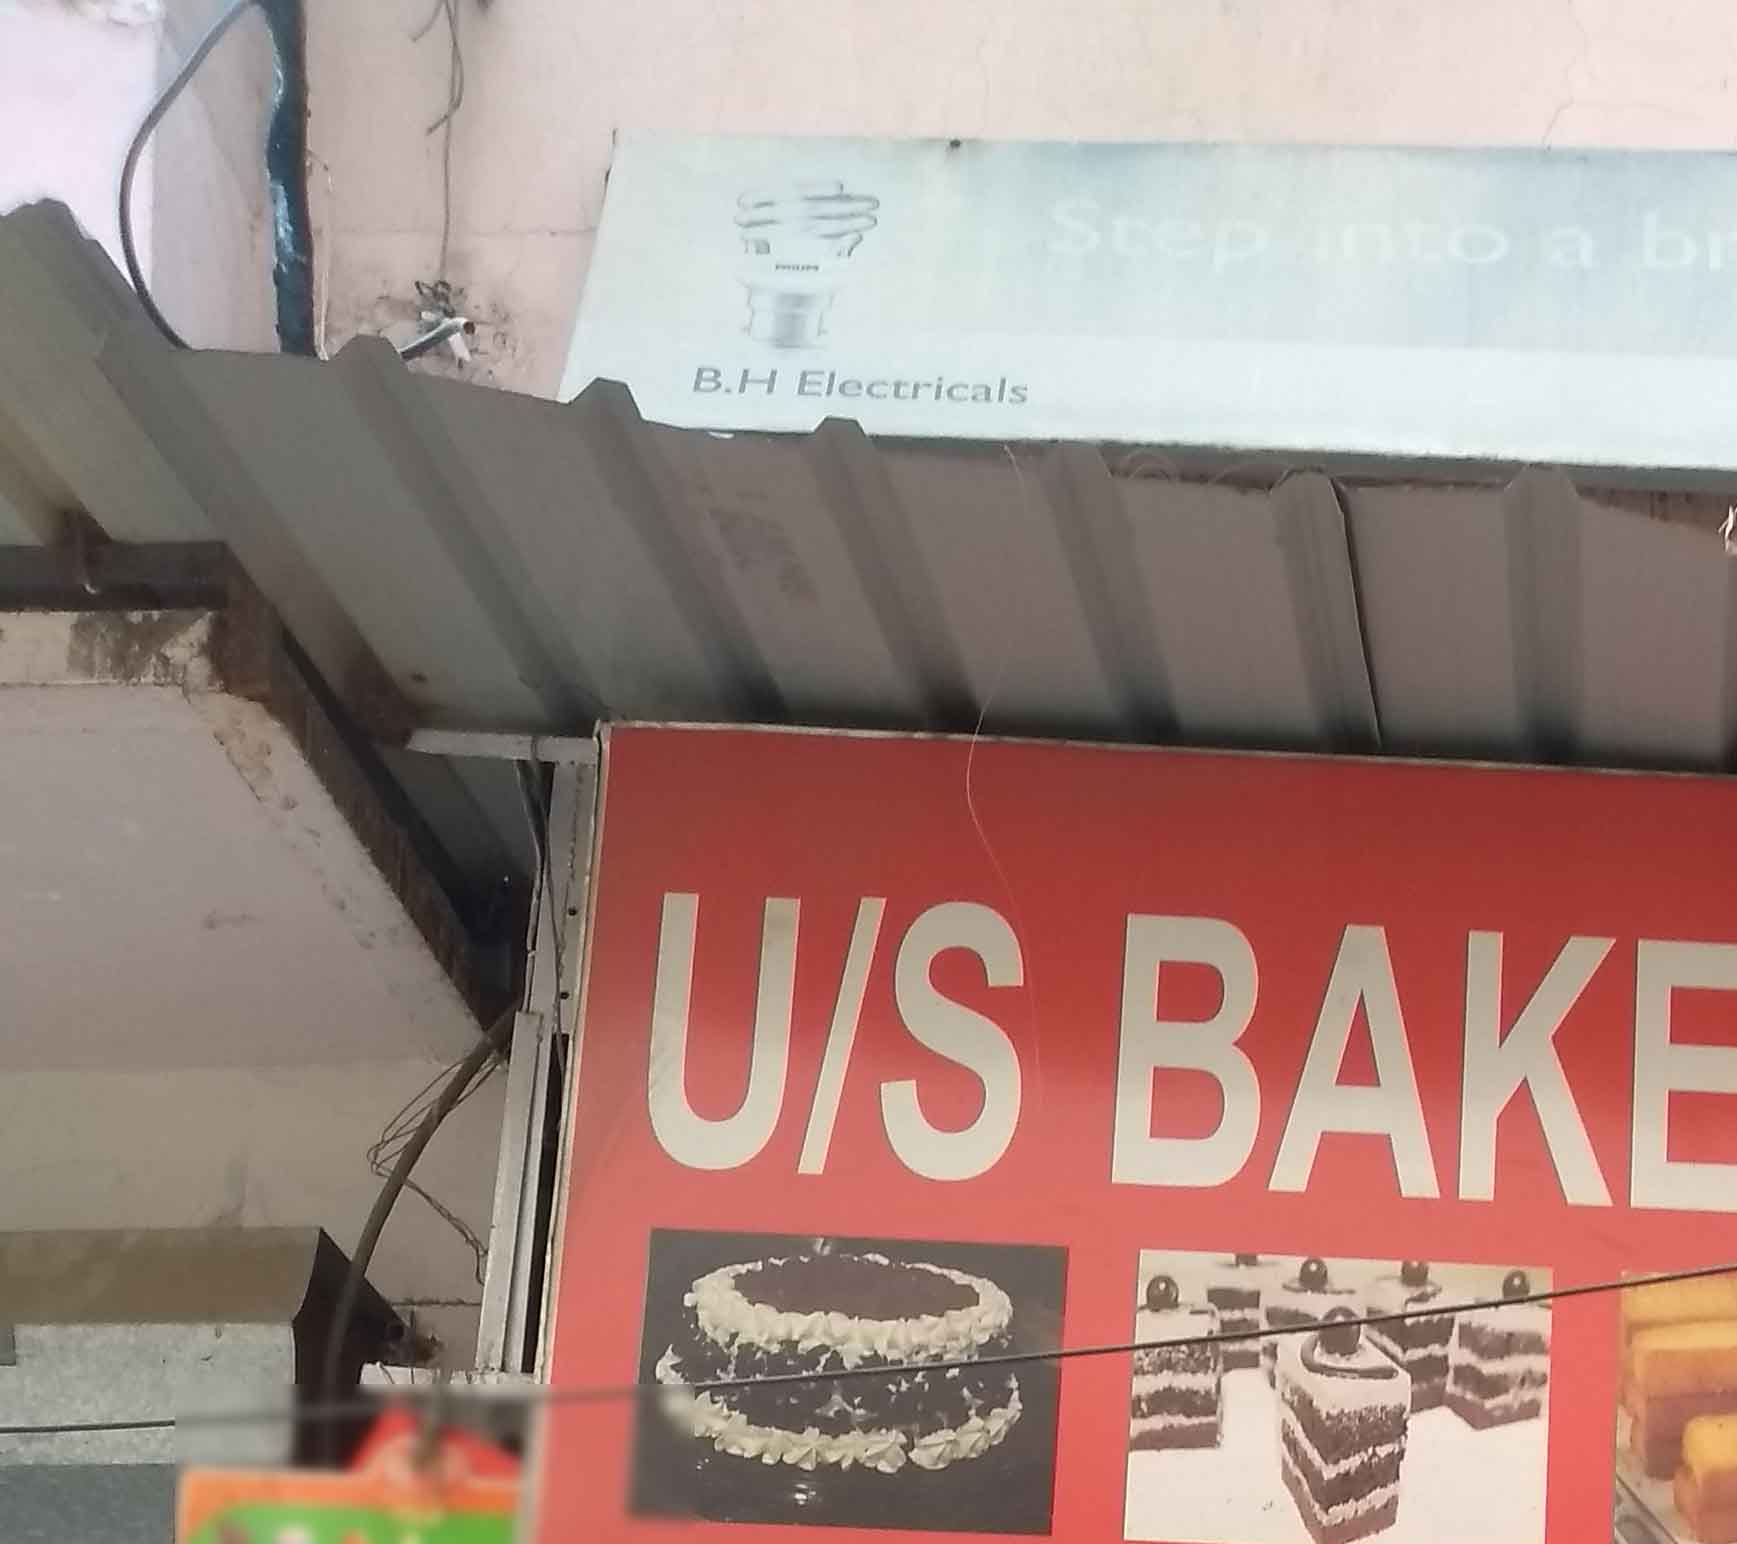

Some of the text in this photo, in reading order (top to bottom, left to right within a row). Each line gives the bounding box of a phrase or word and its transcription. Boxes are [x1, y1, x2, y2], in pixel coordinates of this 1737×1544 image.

[1047, 195, 1269, 276] Step
[1547, 224, 1597, 270] a
[692, 366, 1030, 404] B.H Electricals
[647, 892, 1025, 1182] U/S
